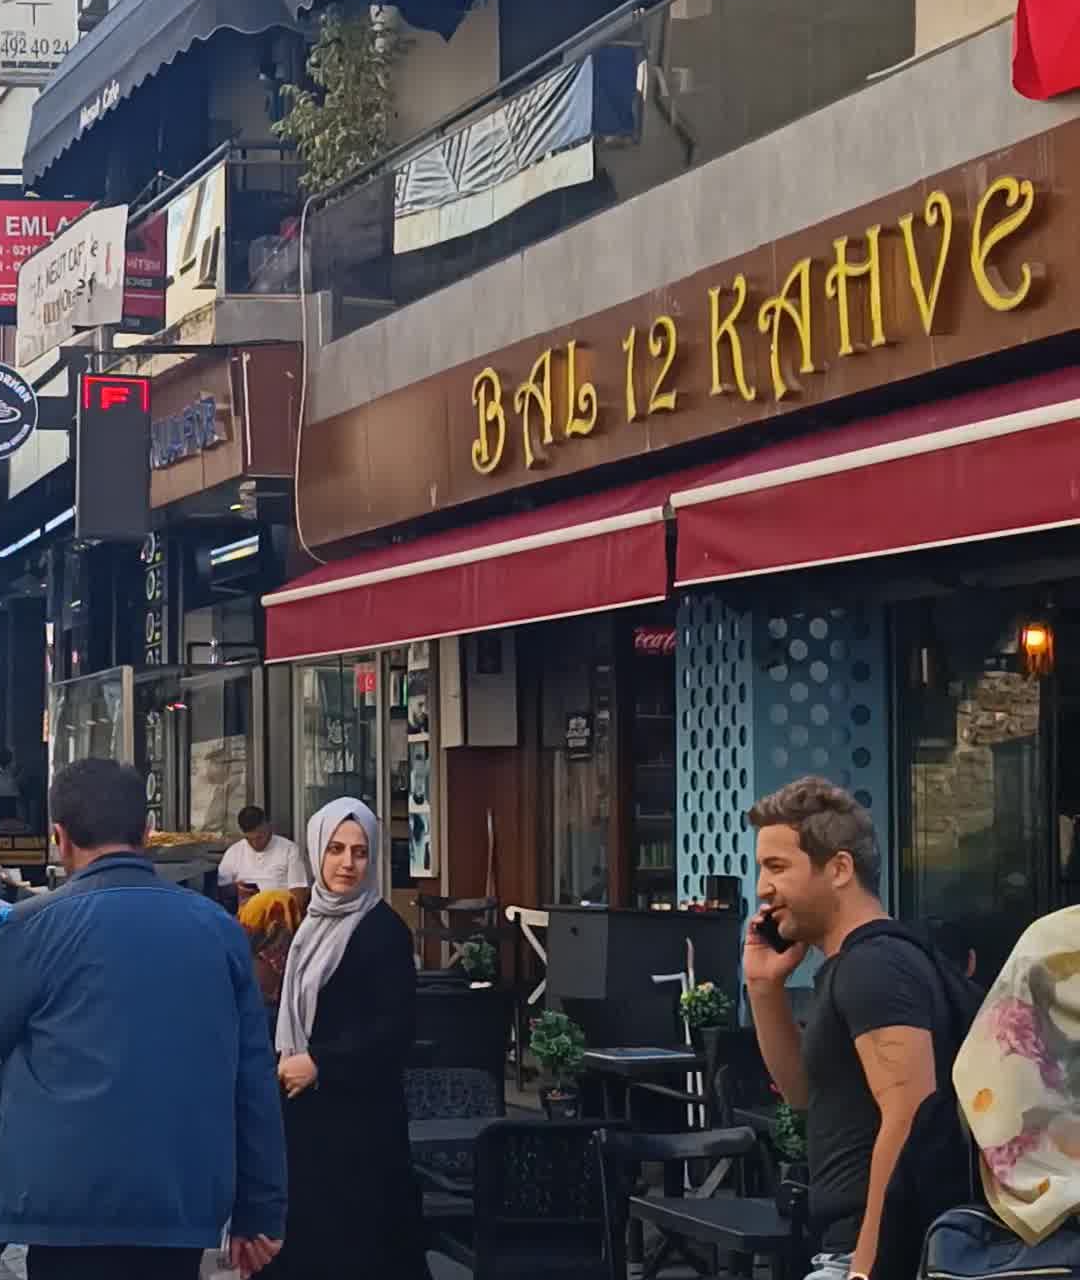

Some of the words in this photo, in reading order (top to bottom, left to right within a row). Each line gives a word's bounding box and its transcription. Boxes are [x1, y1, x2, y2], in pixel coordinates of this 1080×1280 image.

[0, 37, 26, 58] 492
[31, 38, 50, 59] 40
[471, 338, 598, 475] BAL
[621, 316, 678, 423] 12
[707, 176, 1035, 402] KAHVE
